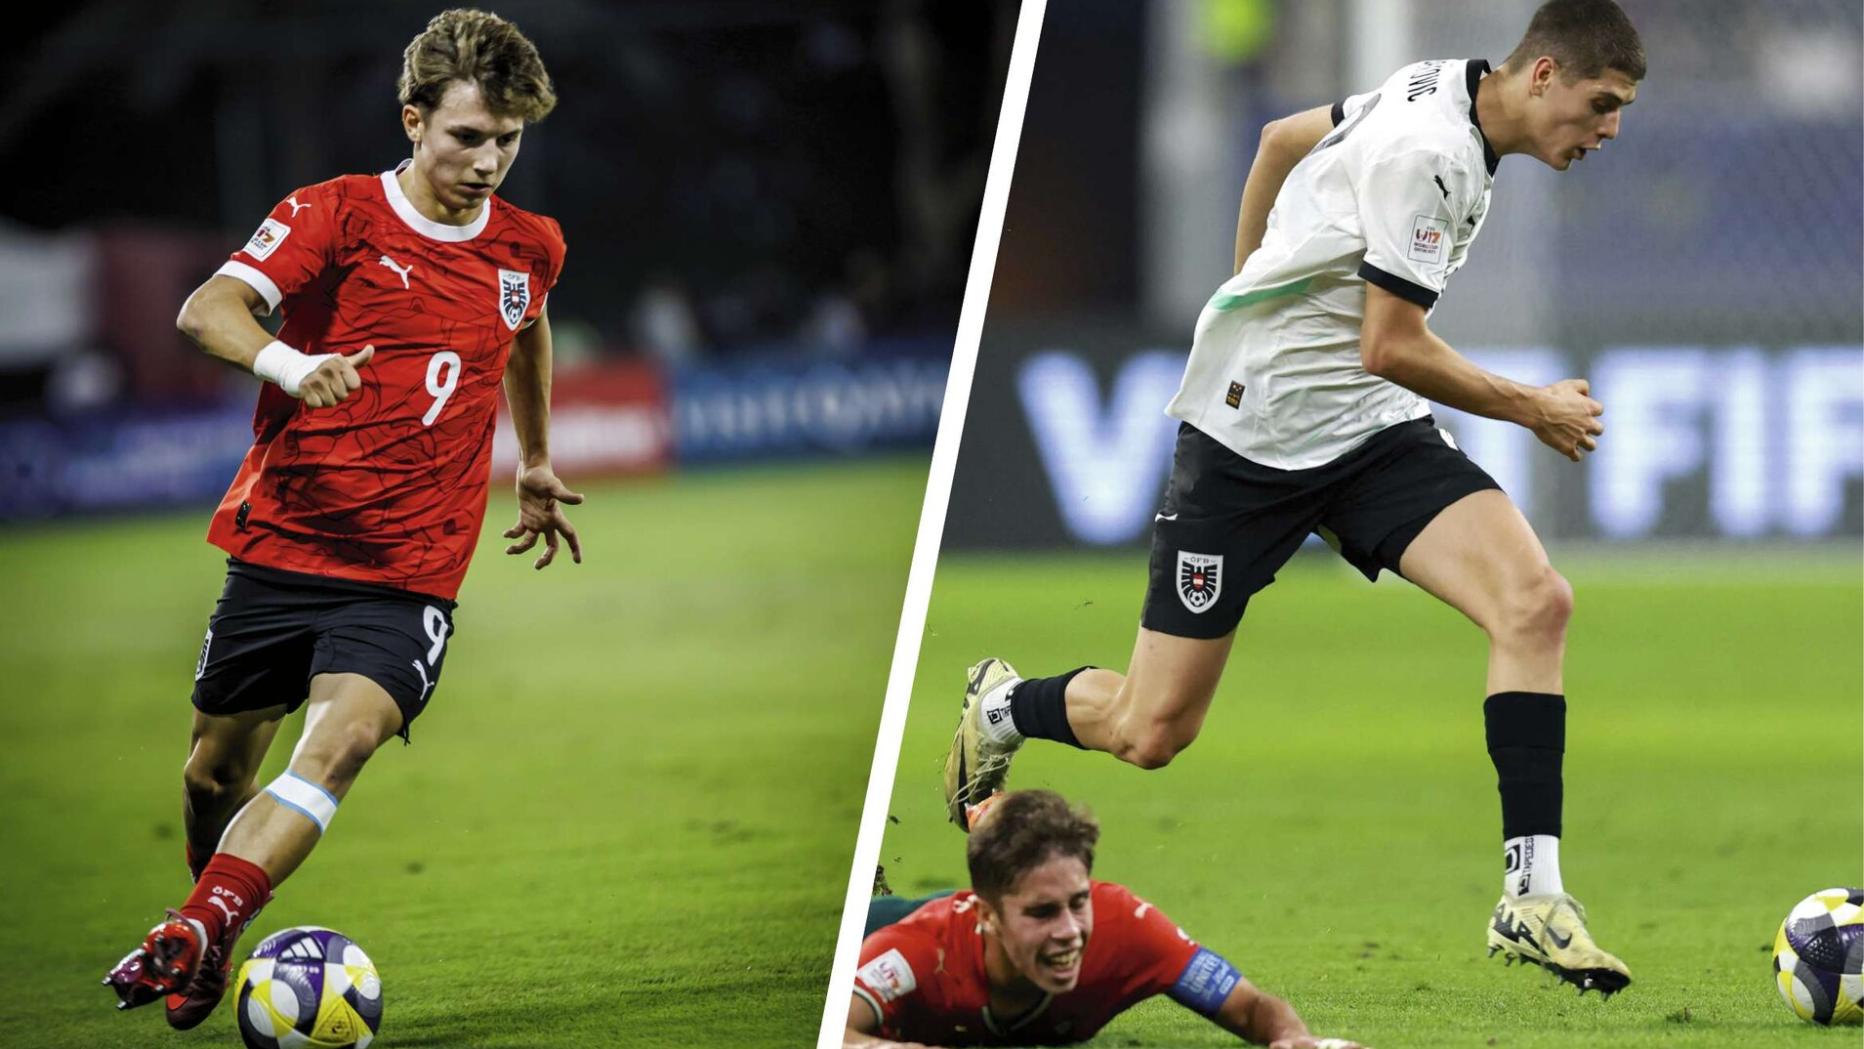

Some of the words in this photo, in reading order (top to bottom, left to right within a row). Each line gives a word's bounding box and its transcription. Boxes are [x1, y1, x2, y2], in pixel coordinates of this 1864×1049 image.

[1406, 62, 1442, 102] OVIC
[422, 351, 462, 426] 9
[423, 605, 449, 667] 9
